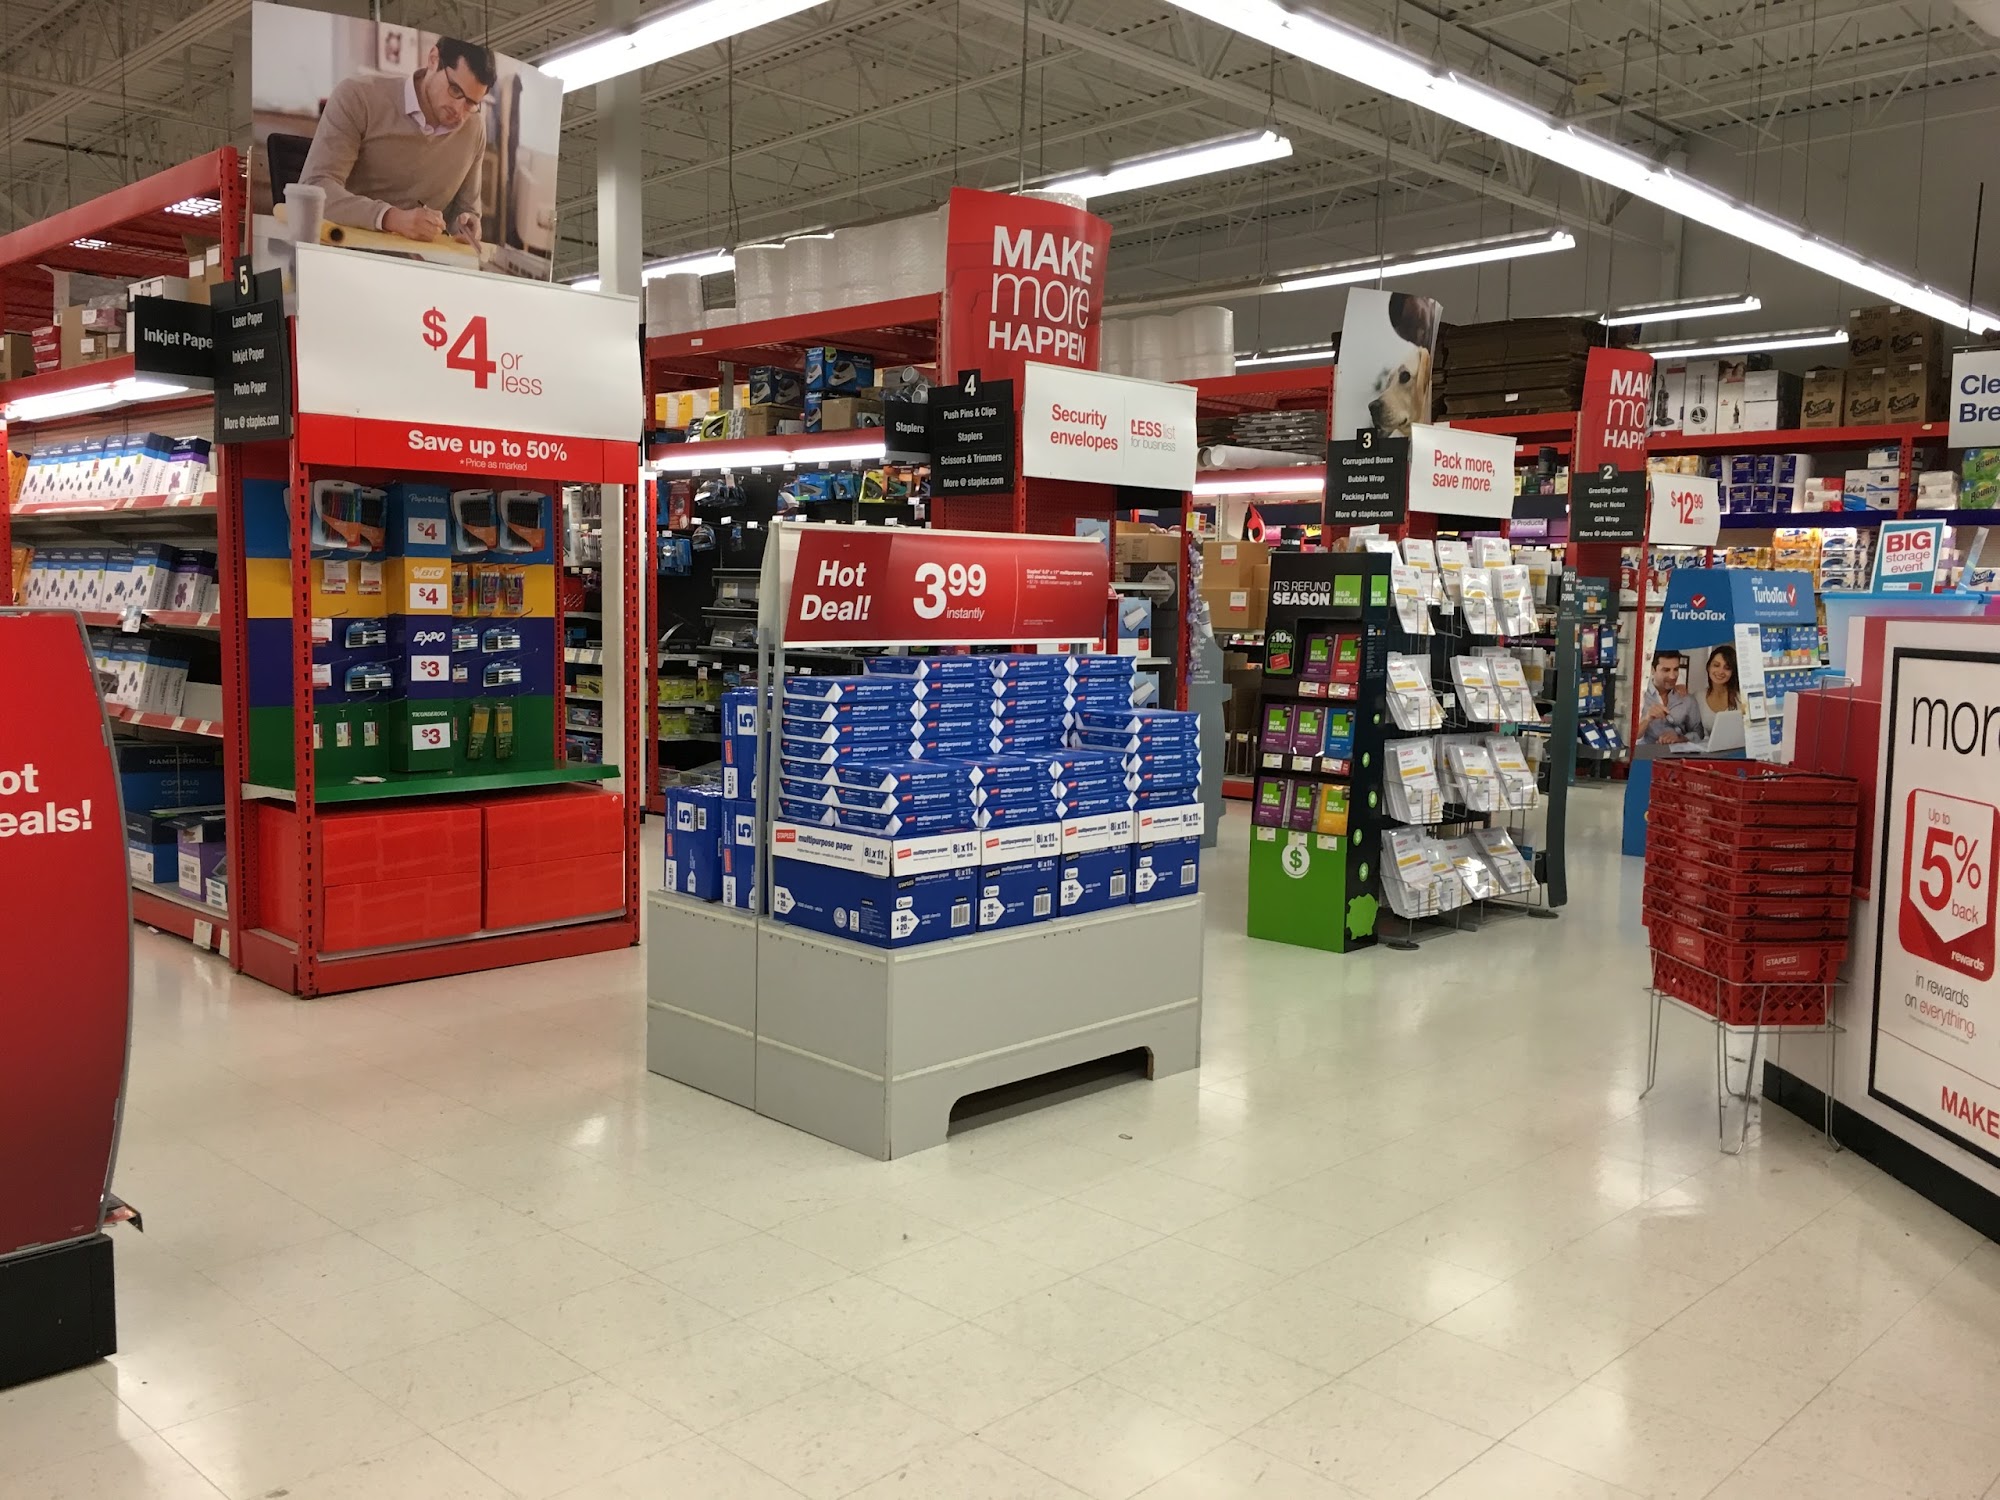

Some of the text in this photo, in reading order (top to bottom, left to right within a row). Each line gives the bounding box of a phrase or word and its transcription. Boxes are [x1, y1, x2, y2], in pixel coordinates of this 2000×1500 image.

[993, 225, 1094, 284] MAKE
[240, 265, 249, 295] 5
[992, 272, 1090, 329] more
[232, 312, 263, 328] Laser Paper
[144, 328, 213, 350] Inkjet Pape
[422, 306, 496, 389] $4
[988, 321, 1086, 363] HAPPEN
[232, 347, 264, 364] Inkjet Paper
[501, 352, 524, 370] or
[234, 381, 267, 396] Photo Paper
[501, 370, 543, 395] less
[964, 374, 976, 396] 4
[1610, 369, 1651, 398] MAK
[1961, 375, 2000, 395] Cle
[944, 407, 997, 420] Push Pins & Clips
[1052, 404, 1107, 430] Security
[1607, 399, 1646, 428] mo
[1959, 403, 2000, 423] Bre
[224, 414, 279, 430] More @ staples.com
[896, 422, 924, 434] Staplers
[408, 430, 567, 461] Save up to 50%
[958, 432, 983, 442] Staplers
[1051, 431, 1118, 452] envelopes
[1131, 436, 1176, 452] for business
[1362, 433, 1372, 449] 3
[1604, 429, 1645, 450] HAPP
[466, 458, 527, 471] Price as marked
[940, 453, 1002, 465] Scissors & Trimmers
[1342, 456, 1393, 466] Corrugated Boxes
[1434, 449, 1495, 476] Pack more,
[1369, 475, 1385, 483] Wrap
[1603, 465, 1613, 480] 2
[943, 477, 1004, 488] More @ staples.com
[1433, 472, 1492, 492] save more.
[1589, 486, 1628, 495] Greeting Cards
[1342, 492, 1389, 501] Packing Peanuts
[1358, 510, 1393, 519] staples.com
[1605, 516, 1619, 524] Wrap
[417, 522, 437, 540] $4
[1601, 530, 1633, 538] staples.com
[1886, 531, 1931, 553] BIG
[1886, 551, 1930, 563] storage
[818, 560, 866, 587] Hot
[1563, 571, 1576, 582] 2015
[1891, 563, 1924, 574] event
[1274, 581, 1331, 591] IT'S REFUND
[1753, 586, 1788, 603] TurboTax
[419, 588, 438, 605] $4
[1273, 592, 1330, 606] SEASON
[800, 595, 872, 621] Deal!
[946, 607, 985, 622] instantly
[1670, 610, 1726, 621] TurboTax
[413, 631, 446, 646] EXPO
[420, 661, 439, 677] $3
[740, 713, 753, 728] 5
[1911, 695, 2000, 758] mor
[422, 728, 441, 745] $3
[0, 763, 39, 795] ot
[0, 800, 92, 837] eals!
[679, 809, 690, 824] 5
[1928, 808, 1950, 825] Up to
[738, 822, 751, 838] 5
[798, 835, 853, 851] multipurpose paper
[1920, 827, 1981, 911] 5%
[1952, 899, 1979, 924] back
[1766, 956, 1797, 966] STAPLES
[1951, 951, 1985, 972] rewards
[1915, 971, 1969, 1008] in rewards
[1905, 993, 1976, 1039] on everything.
[1941, 1085, 2000, 1139] MAKE
